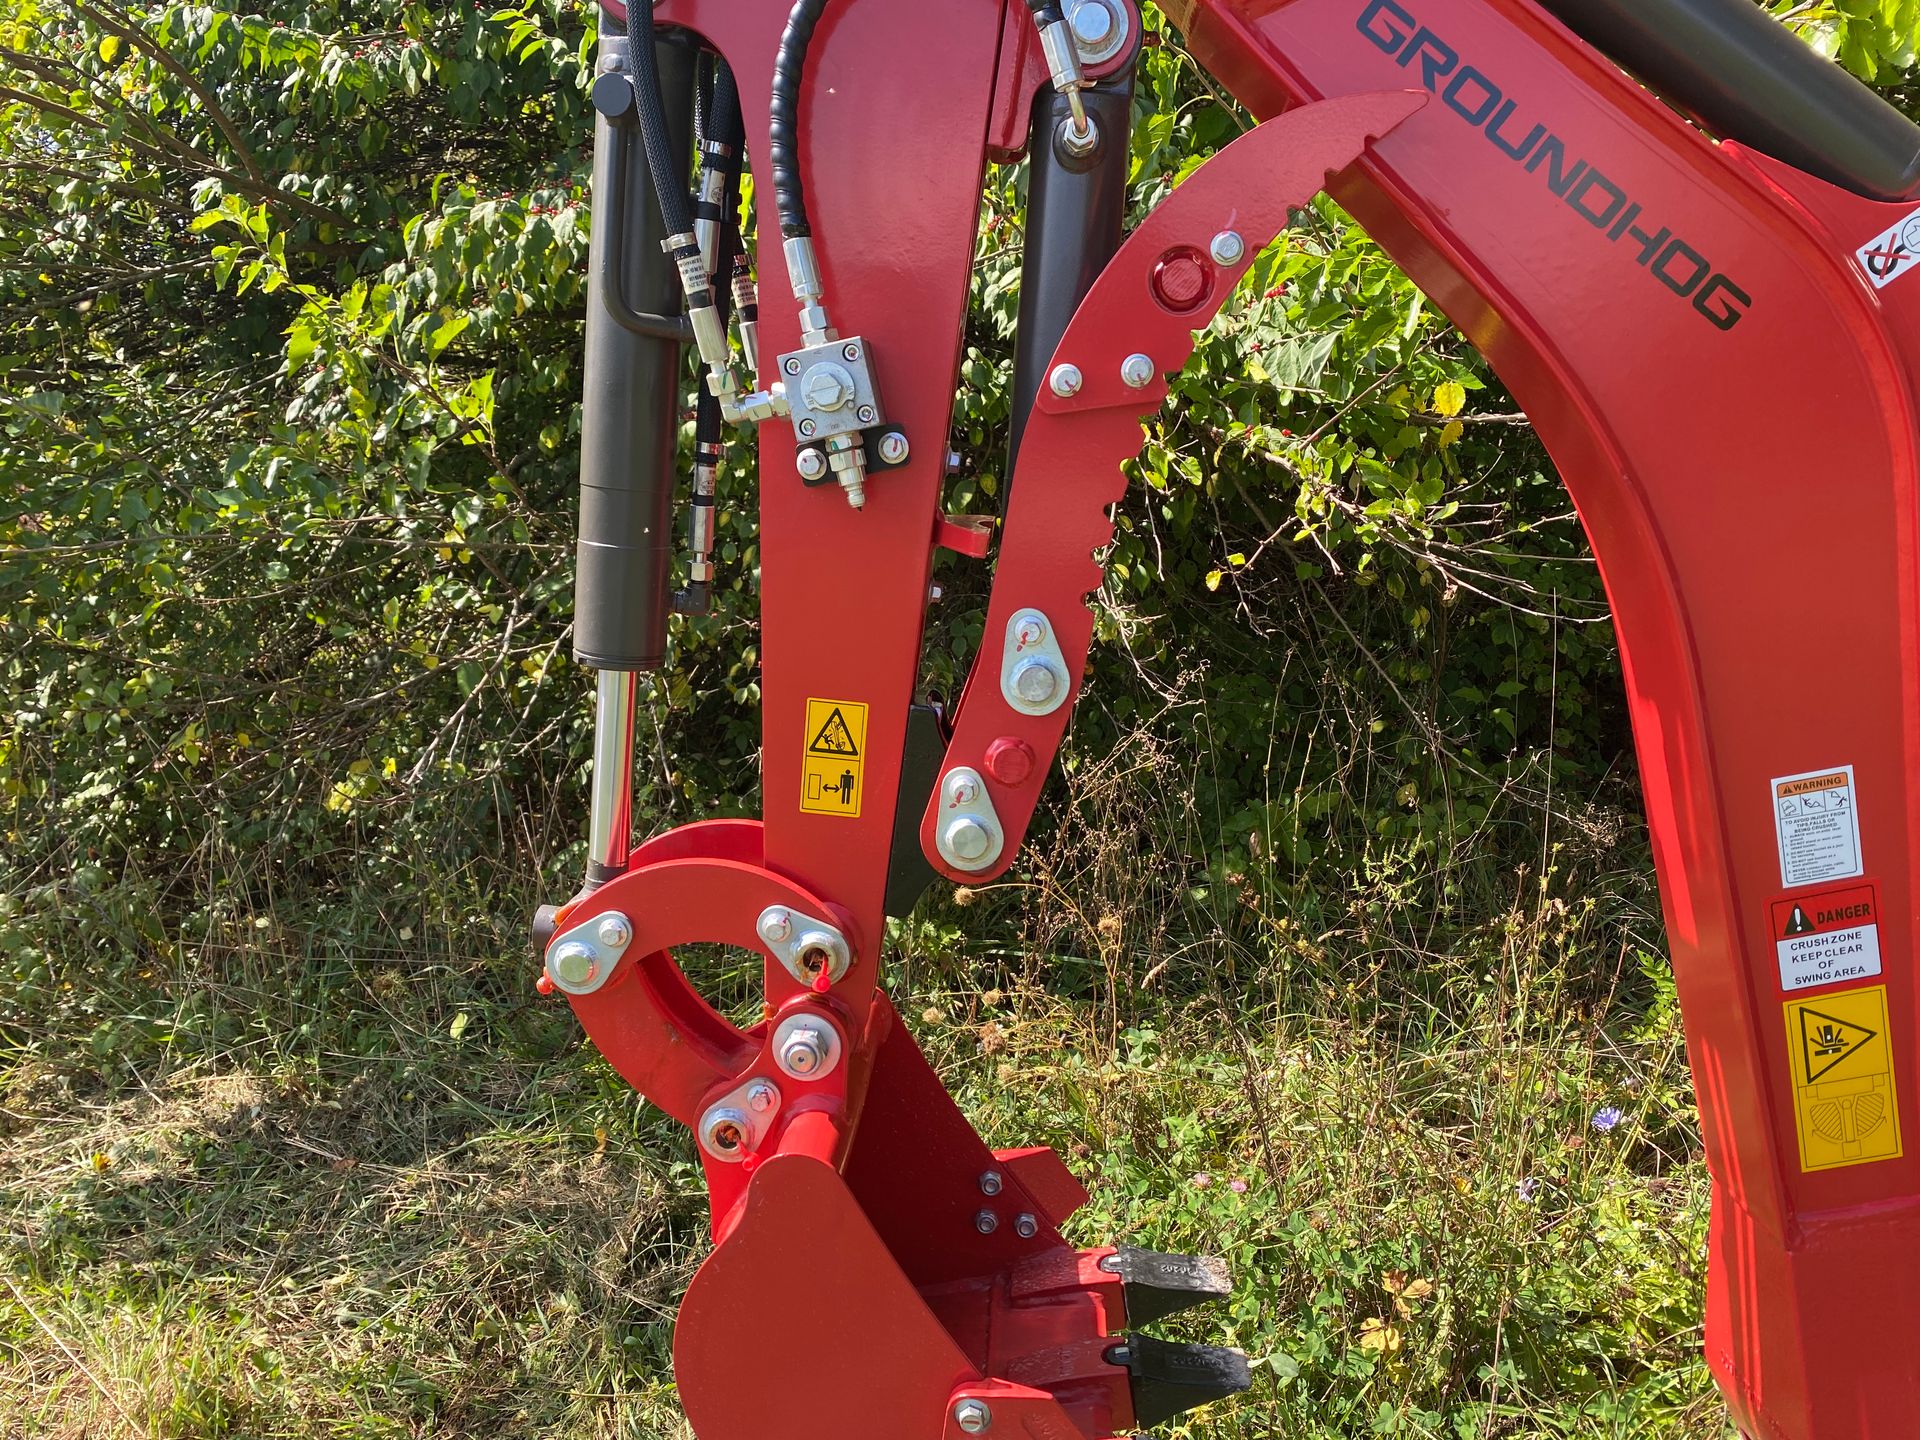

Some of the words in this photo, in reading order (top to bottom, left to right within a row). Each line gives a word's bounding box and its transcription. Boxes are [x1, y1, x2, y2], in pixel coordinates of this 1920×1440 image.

[1356, 0, 1752, 331] GROUNDHOG
[1793, 776, 1842, 791] WARNING
[1817, 903, 1871, 925] DANGER
[1790, 937, 1829, 951] CRUSH
[1831, 931, 1862, 944] ZONE
[1791, 951, 1823, 964] KEEP
[1824, 944, 1863, 958] CLEAR
[1818, 959, 1835, 969] OF
[1795, 971, 1832, 985] SWING
[1834, 965, 1866, 978] AREA
